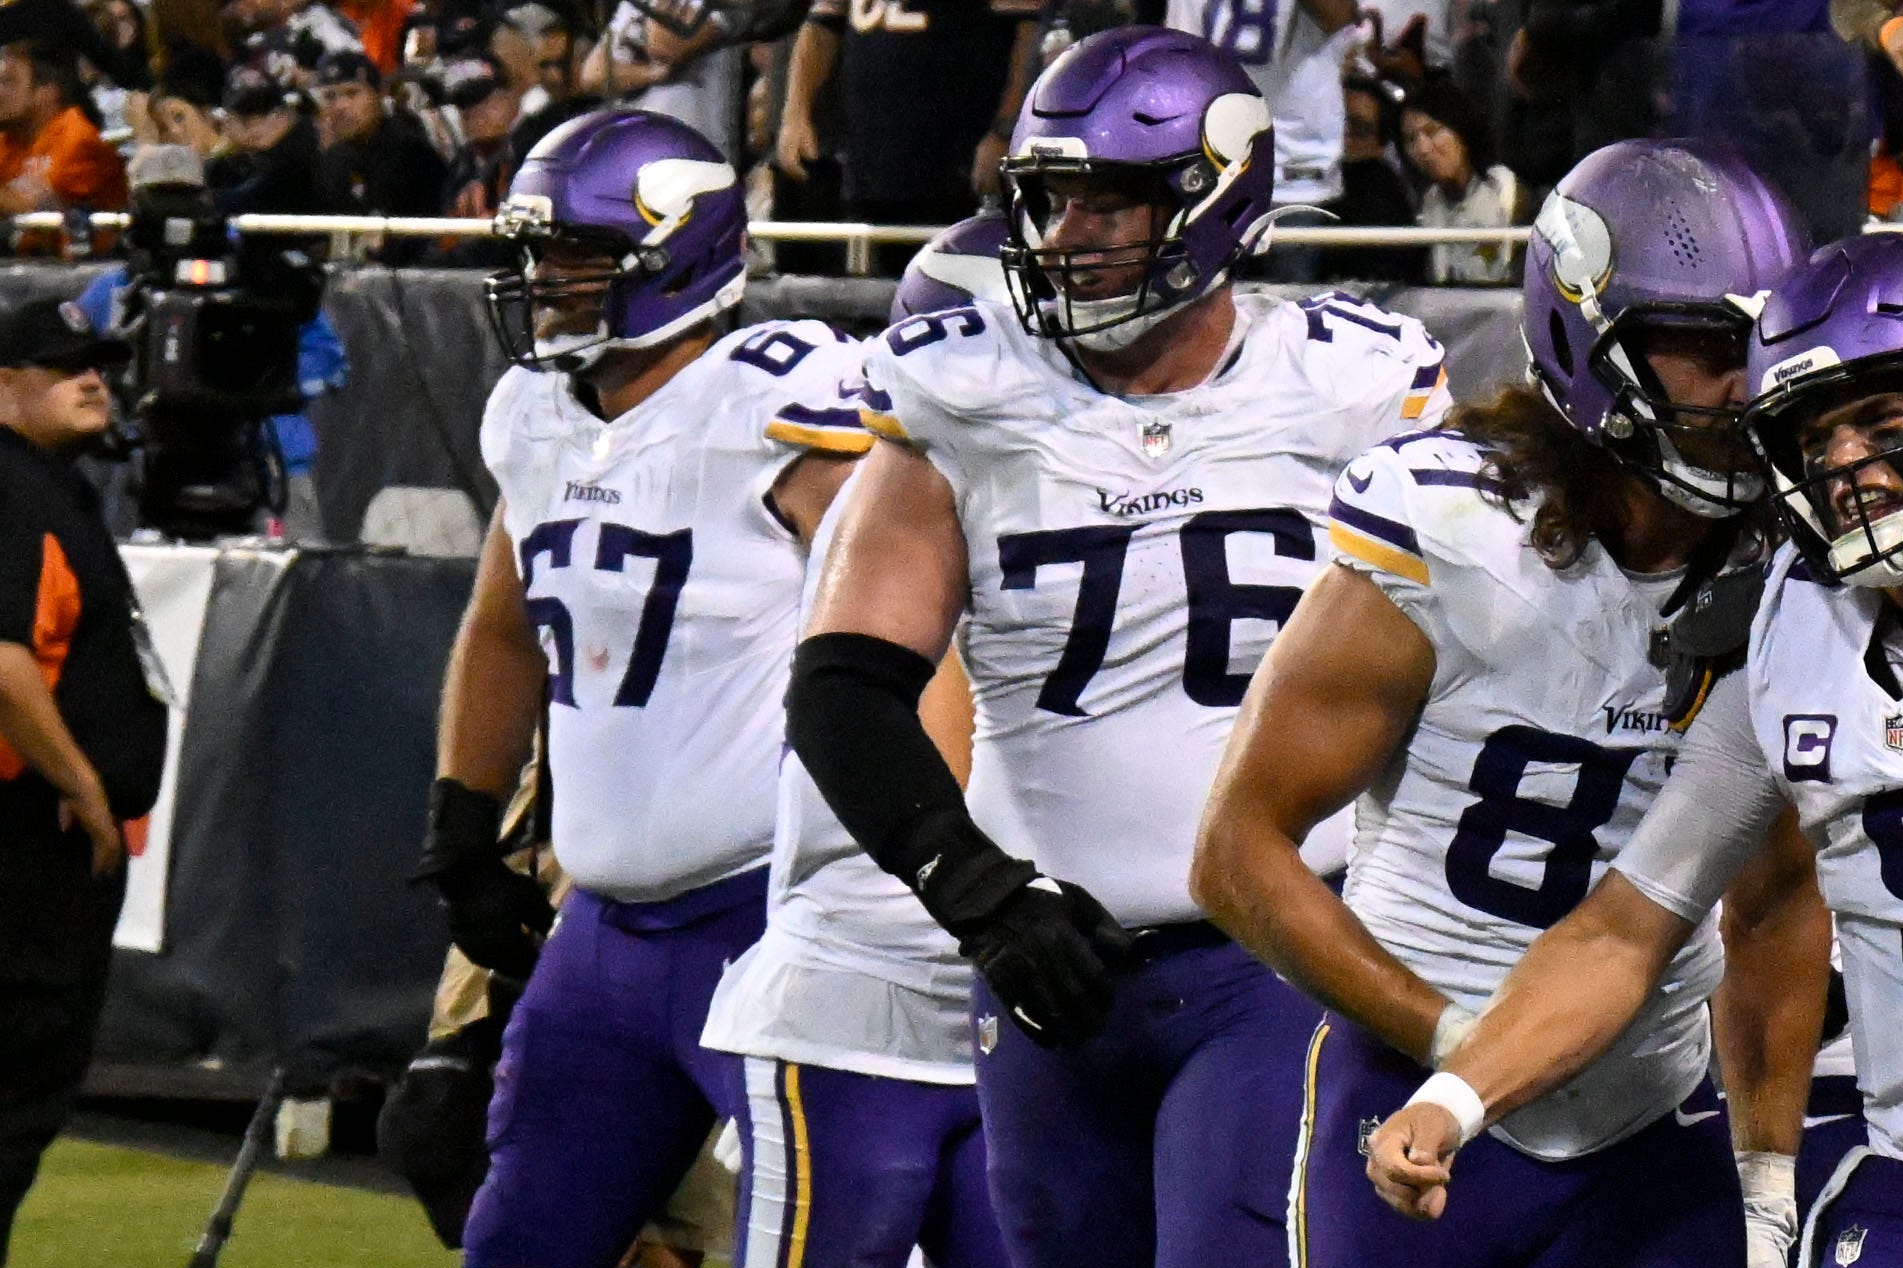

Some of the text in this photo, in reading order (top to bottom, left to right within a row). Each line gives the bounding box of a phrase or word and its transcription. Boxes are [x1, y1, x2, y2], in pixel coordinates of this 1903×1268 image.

[886, 308, 986, 356] 6
[520, 517, 693, 709] 67
[998, 506, 1317, 717] 76
[1445, 724, 1676, 930] 8
[1787, 719, 1831, 766] C
